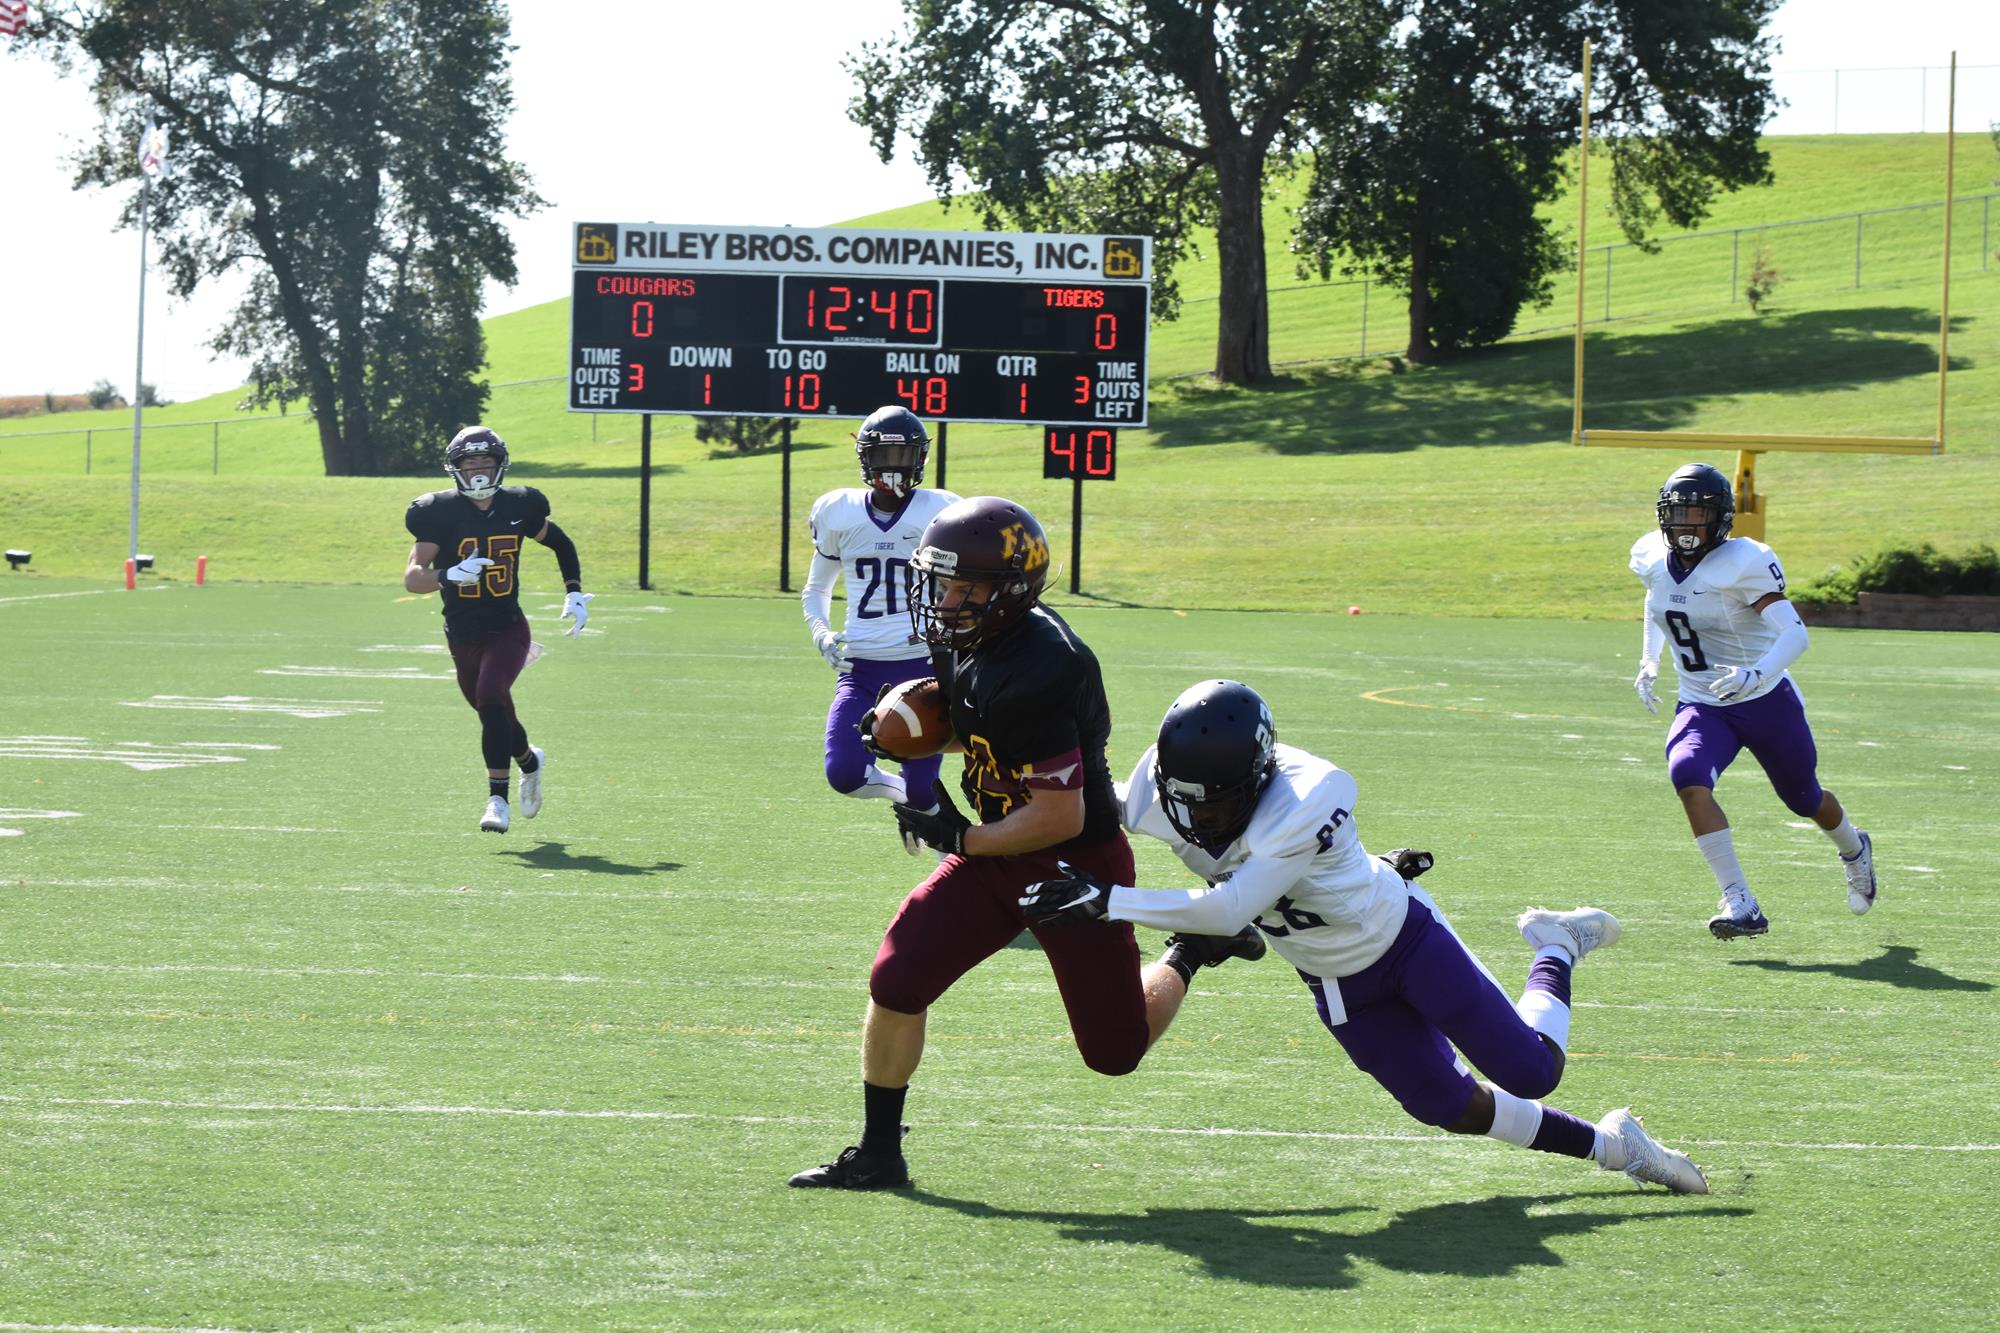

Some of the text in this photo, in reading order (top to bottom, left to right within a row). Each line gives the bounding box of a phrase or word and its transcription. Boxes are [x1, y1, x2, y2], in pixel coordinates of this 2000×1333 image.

[624, 231, 1098, 274] RILEY BROS. COMPANIES, INC.
[597, 276, 696, 297] COUGARS
[1043, 288, 1105, 308] TIGERS
[631, 301, 654, 338] 0
[807, 286, 933, 334] 12:40
[1095, 314, 1117, 350] 0
[581, 348, 622, 366] TIME
[669, 346, 733, 368] DOWN
[766, 349, 827, 370] TO GO
[886, 352, 960, 374] BALL ON
[997, 355, 1037, 377] QTR
[1097, 361, 1138, 379] TIME
[575, 367, 621, 386] OUTS
[627, 364, 644, 391] 3
[704, 373, 711, 405] 1
[1075, 375, 1091, 404] 3
[1095, 381, 1141, 400] OUTS
[578, 387, 620, 406] LEFT
[784, 374, 820, 410] 10
[897, 377, 948, 414] 48
[1020, 382, 1027, 414] 1
[1094, 401, 1136, 419] LEFT
[1050, 429, 1112, 475] 40
[874, 542, 895, 551] TIGERS
[458, 535, 519, 598] 15
[1768, 561, 1786, 592] 9
[855, 557, 914, 619] 20
[1665, 610, 1708, 673] 9
